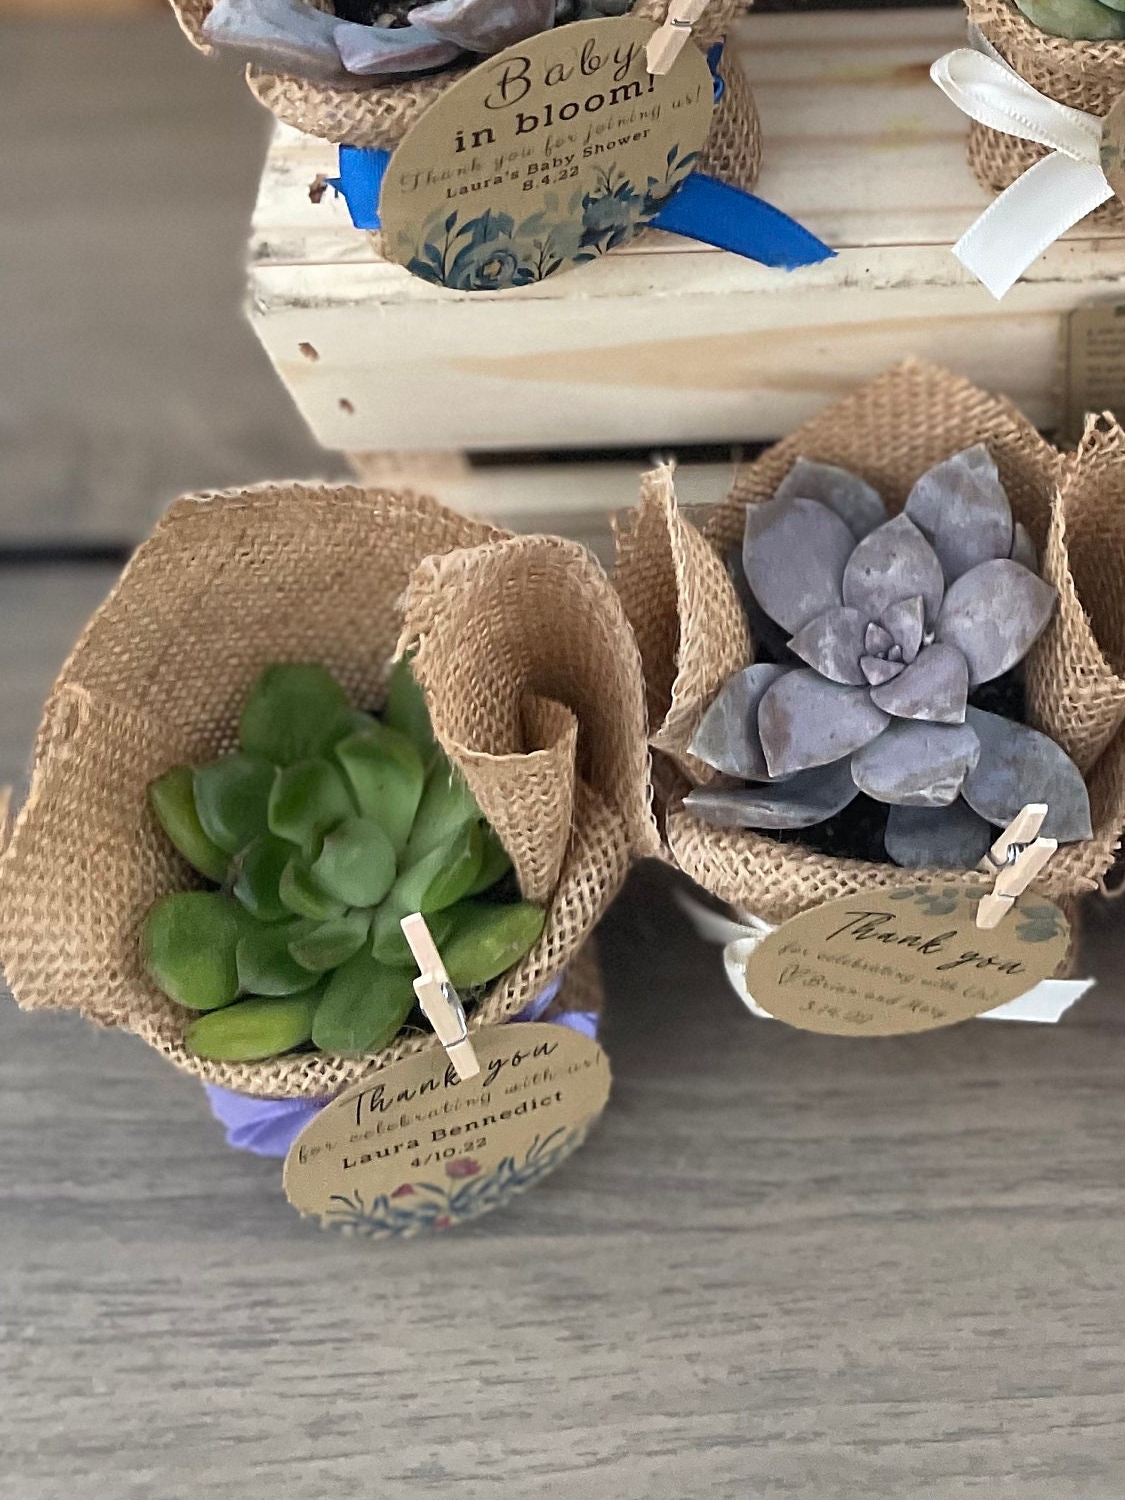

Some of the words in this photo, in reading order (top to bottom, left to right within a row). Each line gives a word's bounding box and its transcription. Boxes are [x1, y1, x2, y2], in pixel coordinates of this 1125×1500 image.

[484, 37, 649, 111] Baby
[401, 156, 483, 193] Thank
[494, 146, 535, 172] you
[544, 130, 578, 157] for
[584, 104, 662, 145] joining
[672, 86, 702, 112] us!
[454, 126, 497, 154] in
[515, 74, 658, 137] bloom!
[446, 171, 521, 200] Laura's
[526, 153, 576, 177] Baby
[582, 128, 652, 160] Shower
[521, 164, 582, 192] 8.4.22
[826, 910, 958, 954] Thank
[936, 949, 1026, 976] you
[299, 1140, 338, 1165] for
[349, 1091, 491, 1143] celebrating
[504, 1072, 556, 1096] with
[566, 1052, 601, 1076] us!
[340, 1065, 463, 1126] Thank
[482, 1041, 559, 1088] you
[342, 1137, 420, 1170] Laura
[431, 1090, 564, 1143] Bennedict
[410, 1136, 488, 1169] 4/10.22
